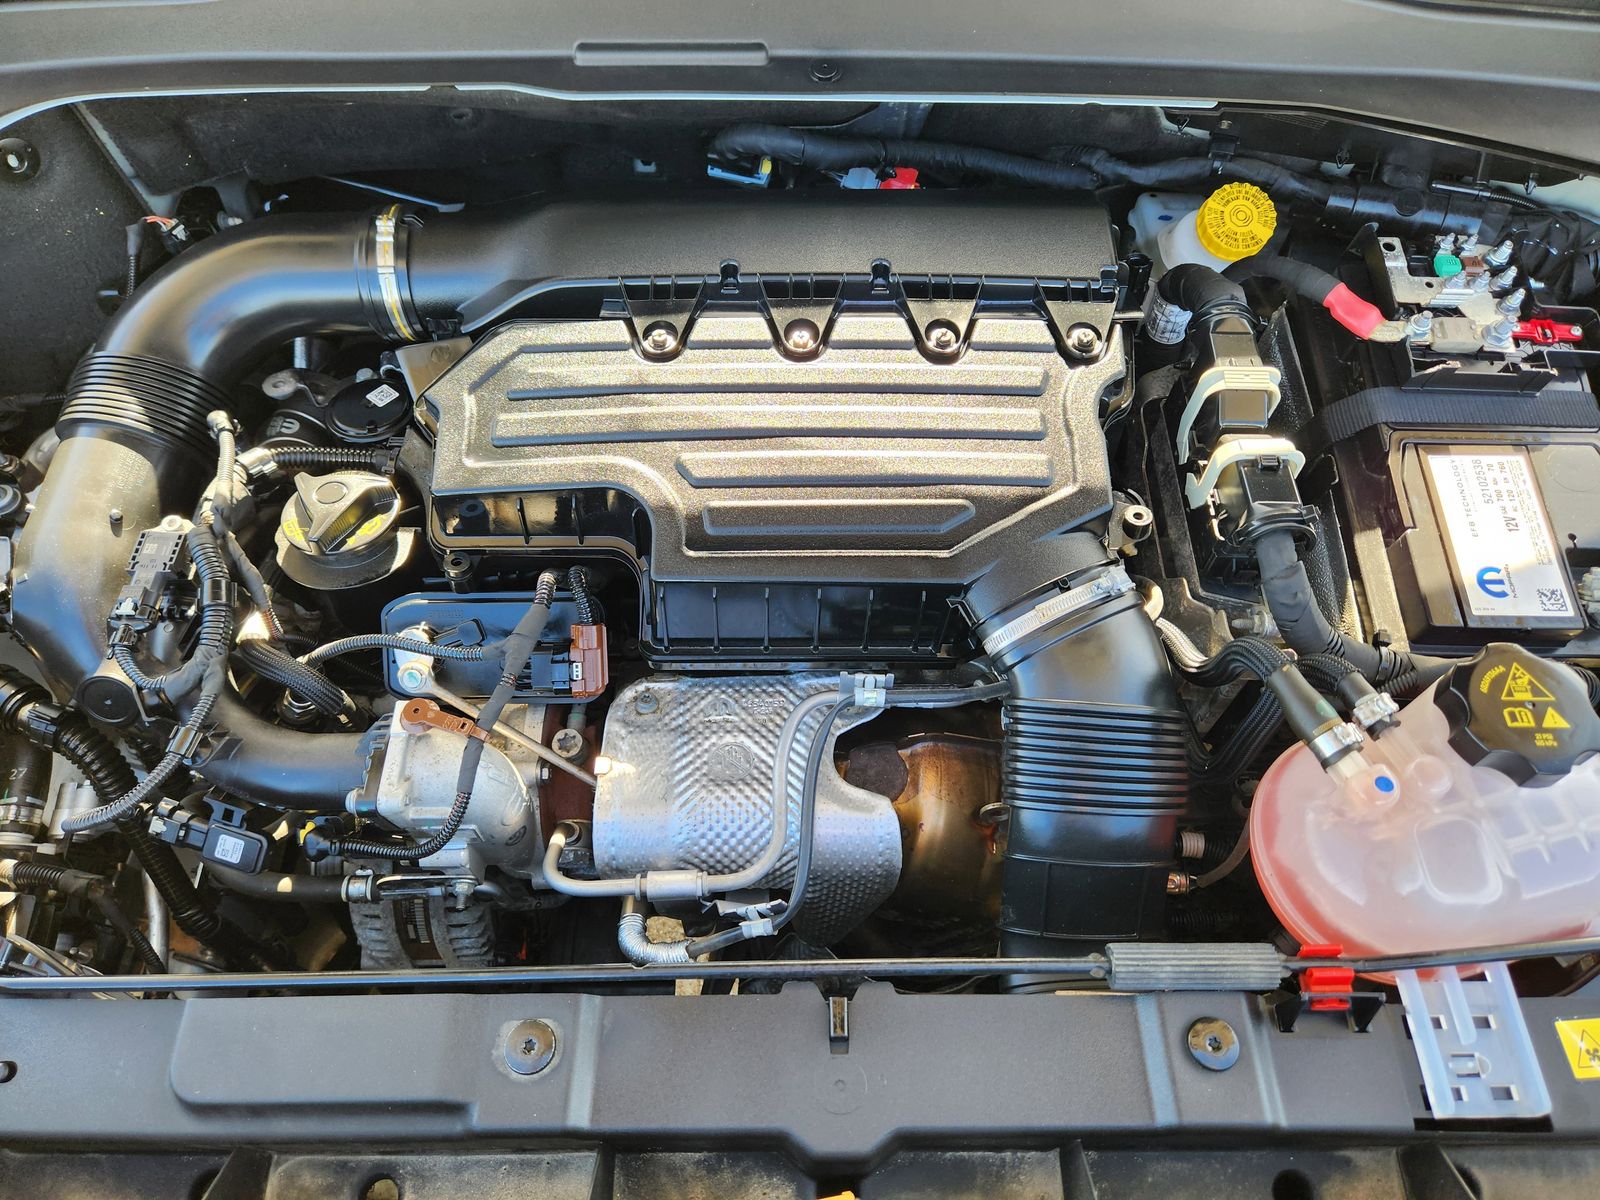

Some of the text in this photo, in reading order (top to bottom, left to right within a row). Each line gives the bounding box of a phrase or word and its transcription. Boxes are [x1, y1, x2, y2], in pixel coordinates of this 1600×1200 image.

[1487, 463, 1495, 472] 70
[1497, 461, 1508, 474] 760
[1450, 459, 1473, 518] TECHNOLOGY
[1472, 459, 1495, 505] 52102538
[1494, 489, 1504, 502] 700
[1506, 489, 1516, 502] 120
[1468, 521, 1479, 538] EFB
[1503, 515, 1520, 533] 12V
[9, 768, 28, 780] 27
